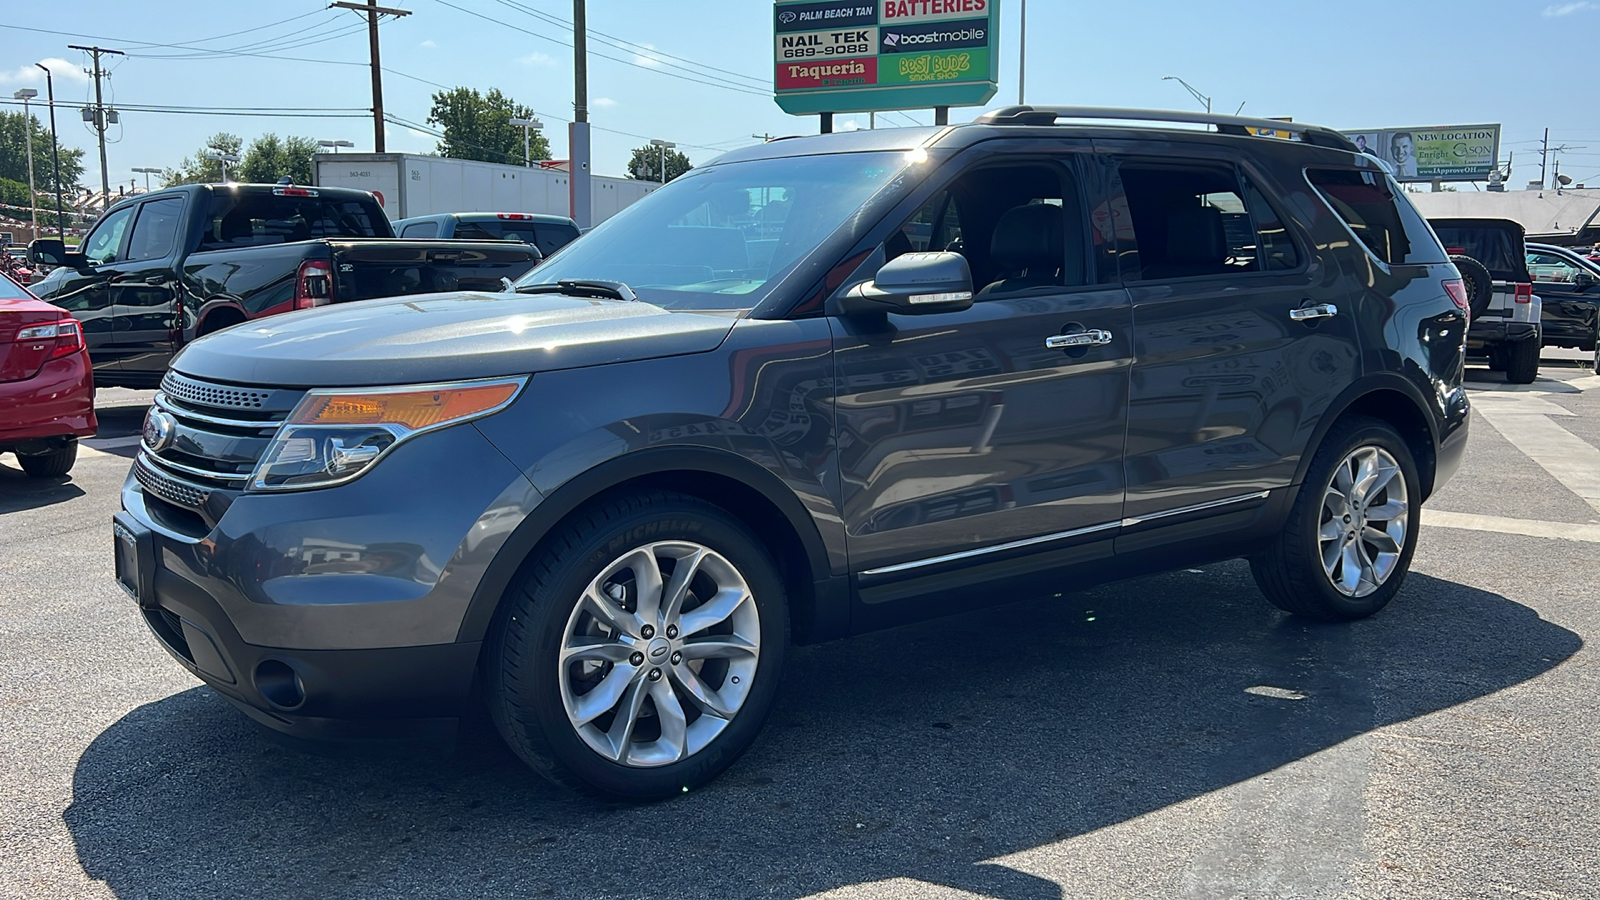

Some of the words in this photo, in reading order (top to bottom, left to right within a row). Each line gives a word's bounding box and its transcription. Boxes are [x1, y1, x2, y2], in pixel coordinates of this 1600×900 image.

[799, 11, 823, 21] PALM
[824, 8, 853, 19] BEACH
[855, 6, 873, 16] TAN
[884, 0, 986, 18] BATTERIES
[781, 34, 823, 48] NAIL
[830, 30, 870, 44] TEK
[783, 43, 869, 58] 689-9088
[932, 53, 970, 73] BUDZ
[936, 71, 959, 80] SHOP
[1416, 133, 1439, 142] NEW
[1440, 131, 1493, 141] LOCATION
[1418, 150, 1449, 160] Enright
[608, 520, 704, 553] MICHELIN
